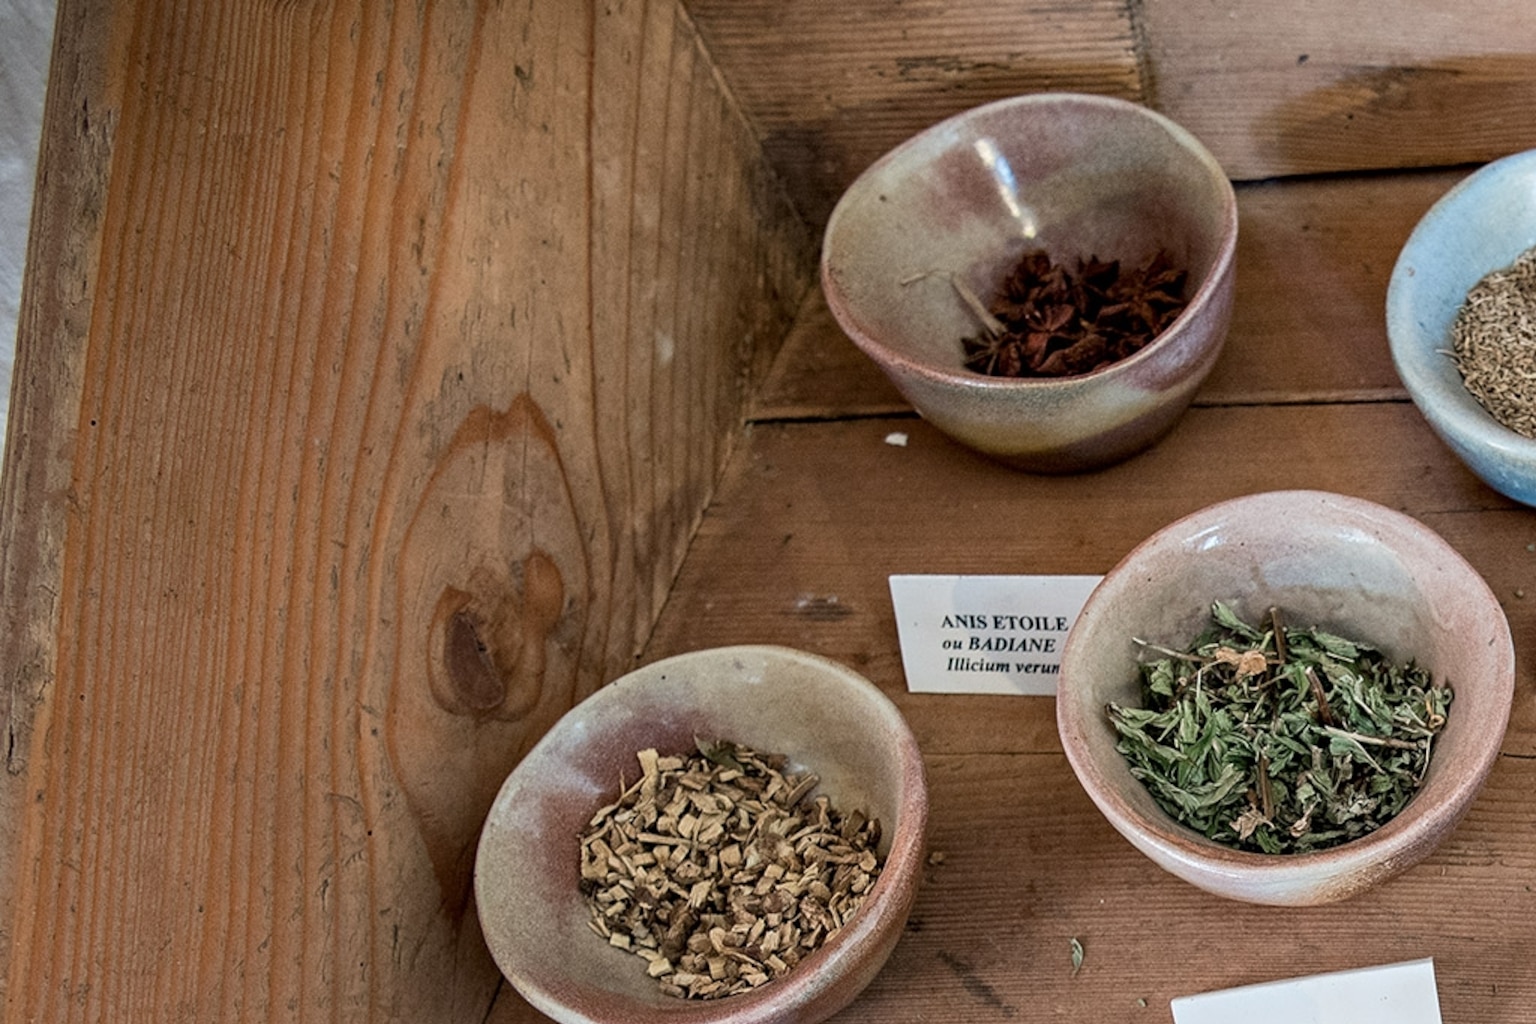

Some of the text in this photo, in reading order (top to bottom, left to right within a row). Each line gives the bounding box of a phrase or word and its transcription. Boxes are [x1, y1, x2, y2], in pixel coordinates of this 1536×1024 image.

[941, 614, 1069, 632] ANIS ETOILE
[941, 636, 1056, 653] ou BADIANE
[946, 657, 1010, 673] Illicium
